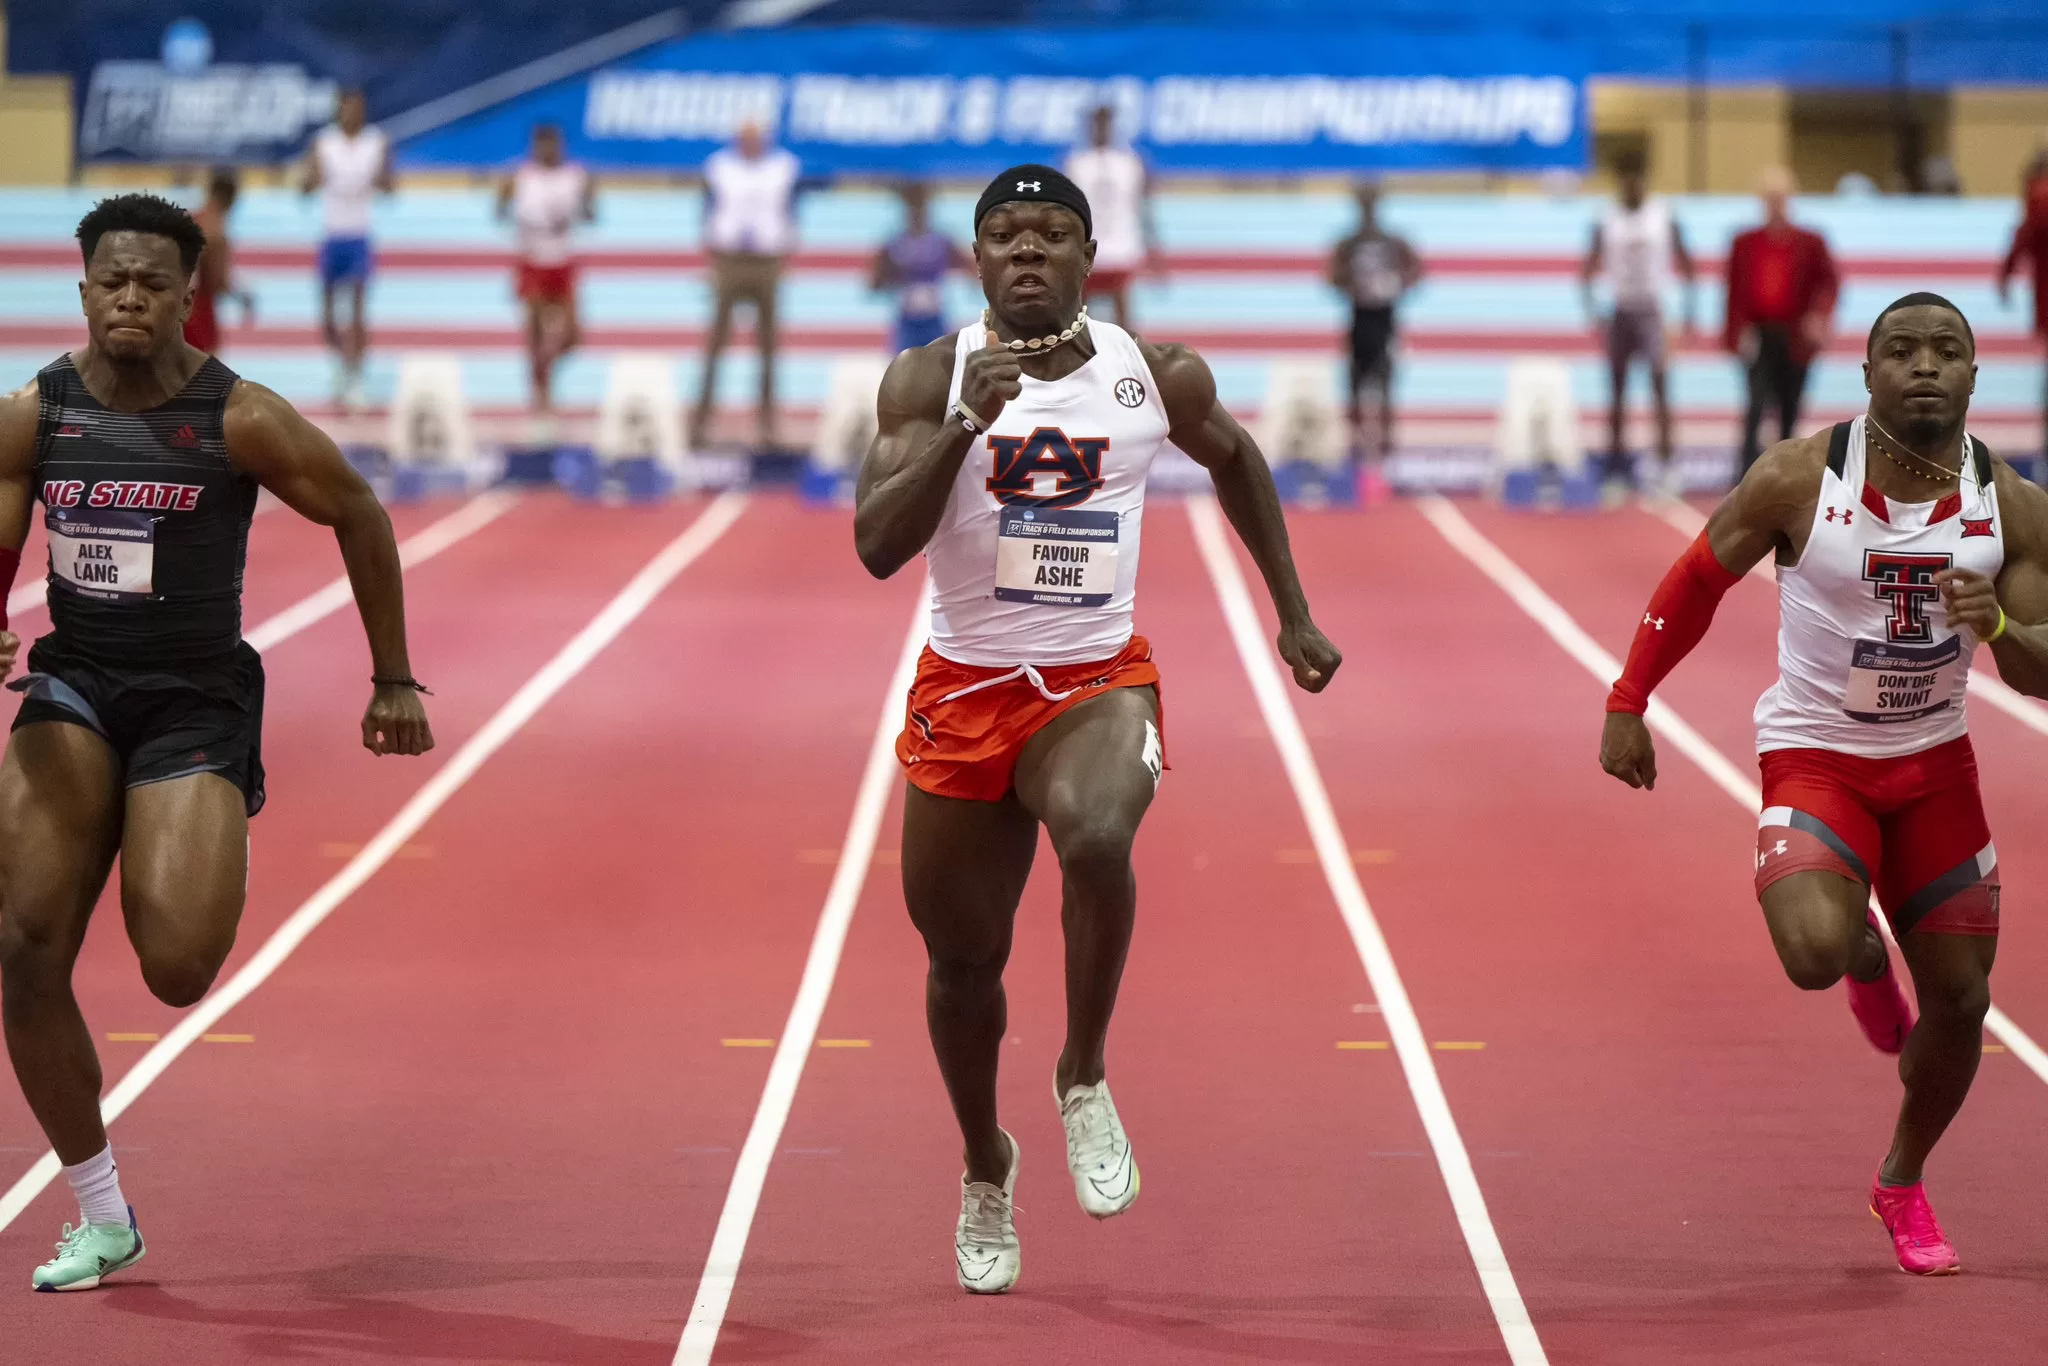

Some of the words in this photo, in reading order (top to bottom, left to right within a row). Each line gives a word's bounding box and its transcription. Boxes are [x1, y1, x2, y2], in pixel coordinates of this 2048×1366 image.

[1116, 380, 1144, 407] SEC
[43, 479, 86, 508] NC
[87, 480, 206, 511] STATE
[81, 526, 98, 534] FIELD
[1022, 524, 1043, 533] TRACK
[1048, 527, 1066, 535] FIELD
[1066, 527, 1115, 537] CHAMPIONSHIPS
[78, 543, 113, 560] ALEX
[1032, 544, 1090, 563] FAVOUR
[73, 561, 119, 584] LANG
[1034, 565, 1084, 587] ASHE
[1877, 671, 1938, 689] DON'DRE
[1876, 688, 1933, 708] SWINT
